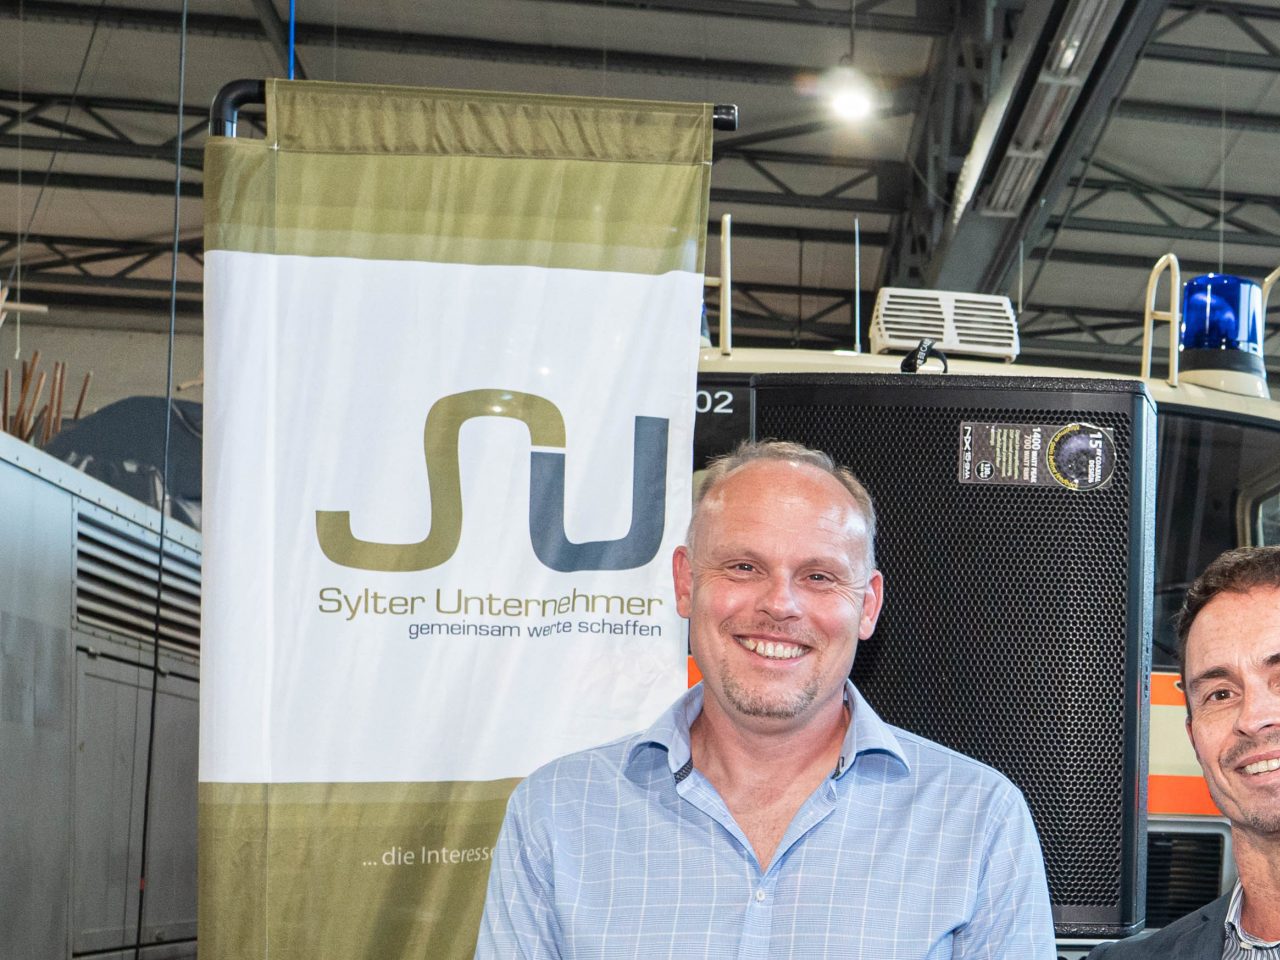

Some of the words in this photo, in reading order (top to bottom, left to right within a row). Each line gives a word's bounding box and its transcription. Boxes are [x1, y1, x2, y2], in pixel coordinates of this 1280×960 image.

[318, 587, 426, 621] Sylter
[435, 588, 664, 617] Unternehmer
[408, 620, 521, 640] gemeinsam
[526, 620, 573, 638] werte
[577, 618, 662, 637] schaffen
